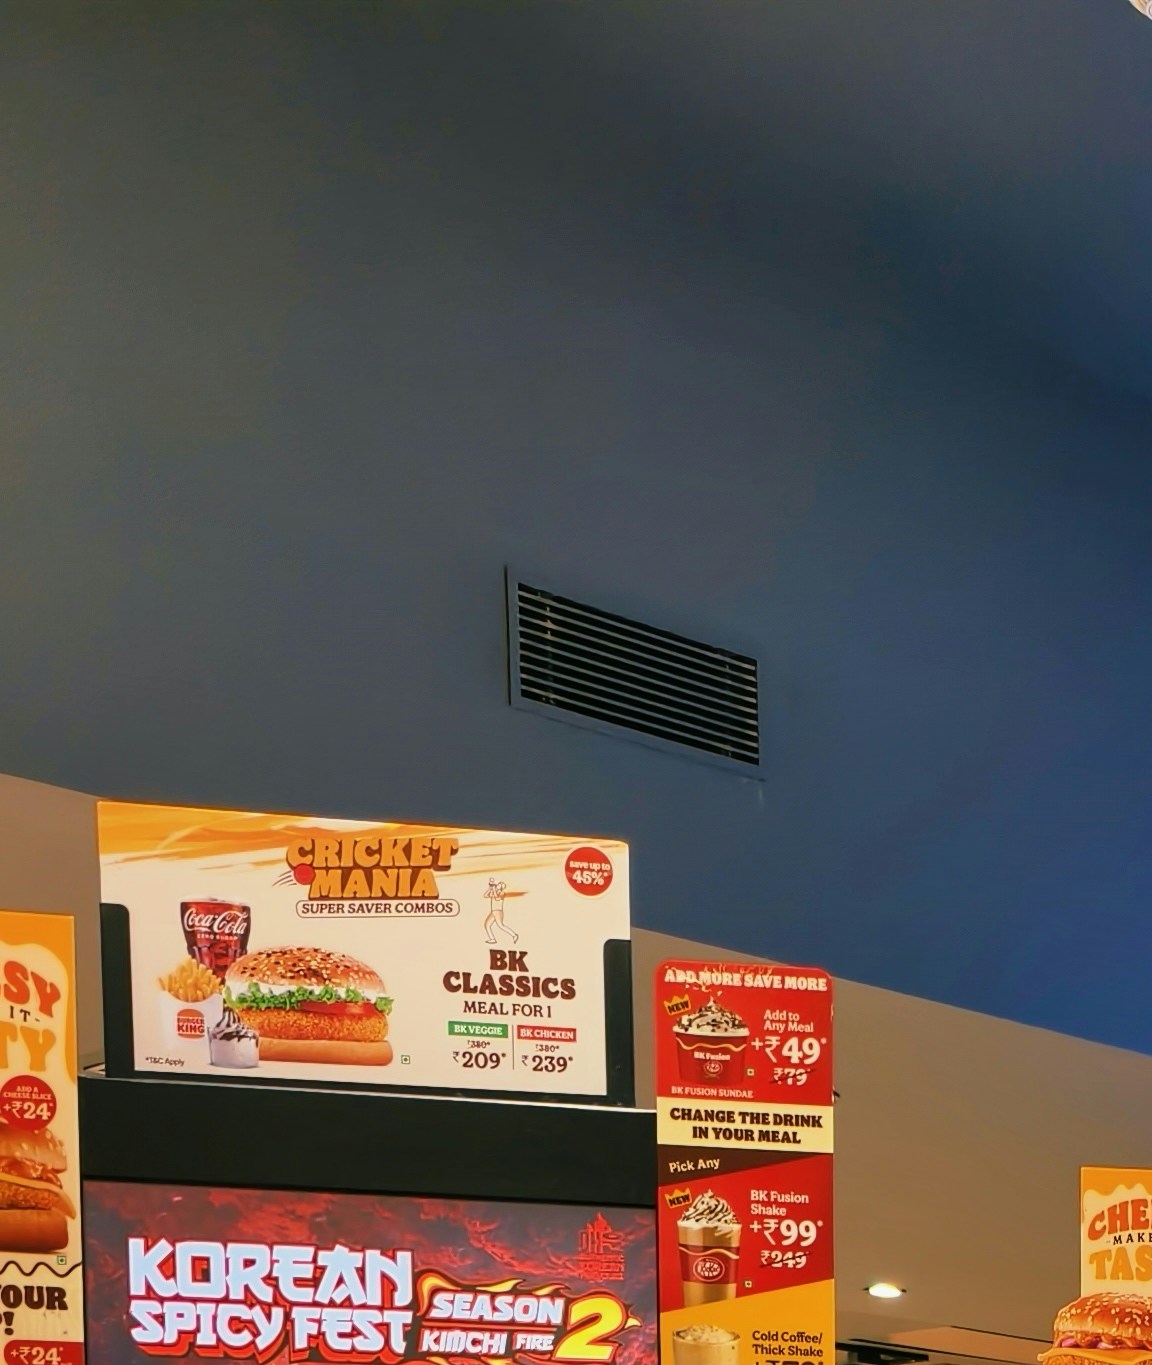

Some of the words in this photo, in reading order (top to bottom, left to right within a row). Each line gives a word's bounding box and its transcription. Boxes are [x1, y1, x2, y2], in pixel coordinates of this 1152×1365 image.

[286, 837, 460, 871] CRICKET
[308, 868, 440, 900] MANIA
[301, 902, 346, 915] SUPER
[347, 902, 393, 915] SAVER
[394, 902, 453, 915] COMBOS
[184, 907, 249, 935] Coca-Cola
[489, 948, 529, 972] BK
[442, 971, 577, 1000] CLASSICS
[664, 969, 696, 984] ADD
[700, 971, 742, 987] MORE
[744, 972, 783, 989] SAVE
[784, 976, 828, 991] MORE
[462, 1000, 509, 1016] MEAL
[511, 1003, 544, 1017] FOR
[667, 1000, 692, 1014] NEW
[764, 1009, 786, 1021] Add
[788, 1011, 800, 1021] to
[177, 1024, 205, 1034] KING
[453, 1025, 467, 1034] BK
[468, 1025, 503, 1036] VEGGIE
[520, 1029, 534, 1038] BK
[535, 1030, 574, 1040] CHICKEN
[764, 1021, 785, 1033] Any
[787, 1022, 814, 1033] Meal
[671, 1085, 684, 1094] BK
[685, 1086, 718, 1097] FUSION
[719, 1088, 754, 1099] SUNDAE
[670, 1107, 736, 1124] CHANGE
[738, 1111, 771, 1125] THE
[773, 1112, 823, 1128] DRINK
[692, 1125, 709, 1139] IN
[711, 1127, 754, 1142] YOUR
[758, 1130, 801, 1144] MEAL
[669, 1159, 695, 1173] Pick
[698, 1158, 720, 1173] Any
[669, 1194, 691, 1207] NEW
[750, 1189, 768, 1201] BK
[771, 1190, 809, 1204] Fusion
[750, 1204, 787, 1216] Shake
[127, 1236, 414, 1308] KOREAN
[0, 1284, 69, 1311] OUR
[431, 1292, 566, 1325] SEASON
[129, 1300, 286, 1352] SPICY
[292, 1305, 414, 1356] FEST
[553, 1296, 625, 1362] 2
[421, 1329, 507, 1356] KIMCHI
[514, 1333, 555, 1353] FIRE
[752, 1330, 778, 1342] Cold
[781, 1331, 823, 1344] Coffee/
[752, 1344, 785, 1356] Thick
[787, 1345, 824, 1357] Shake
